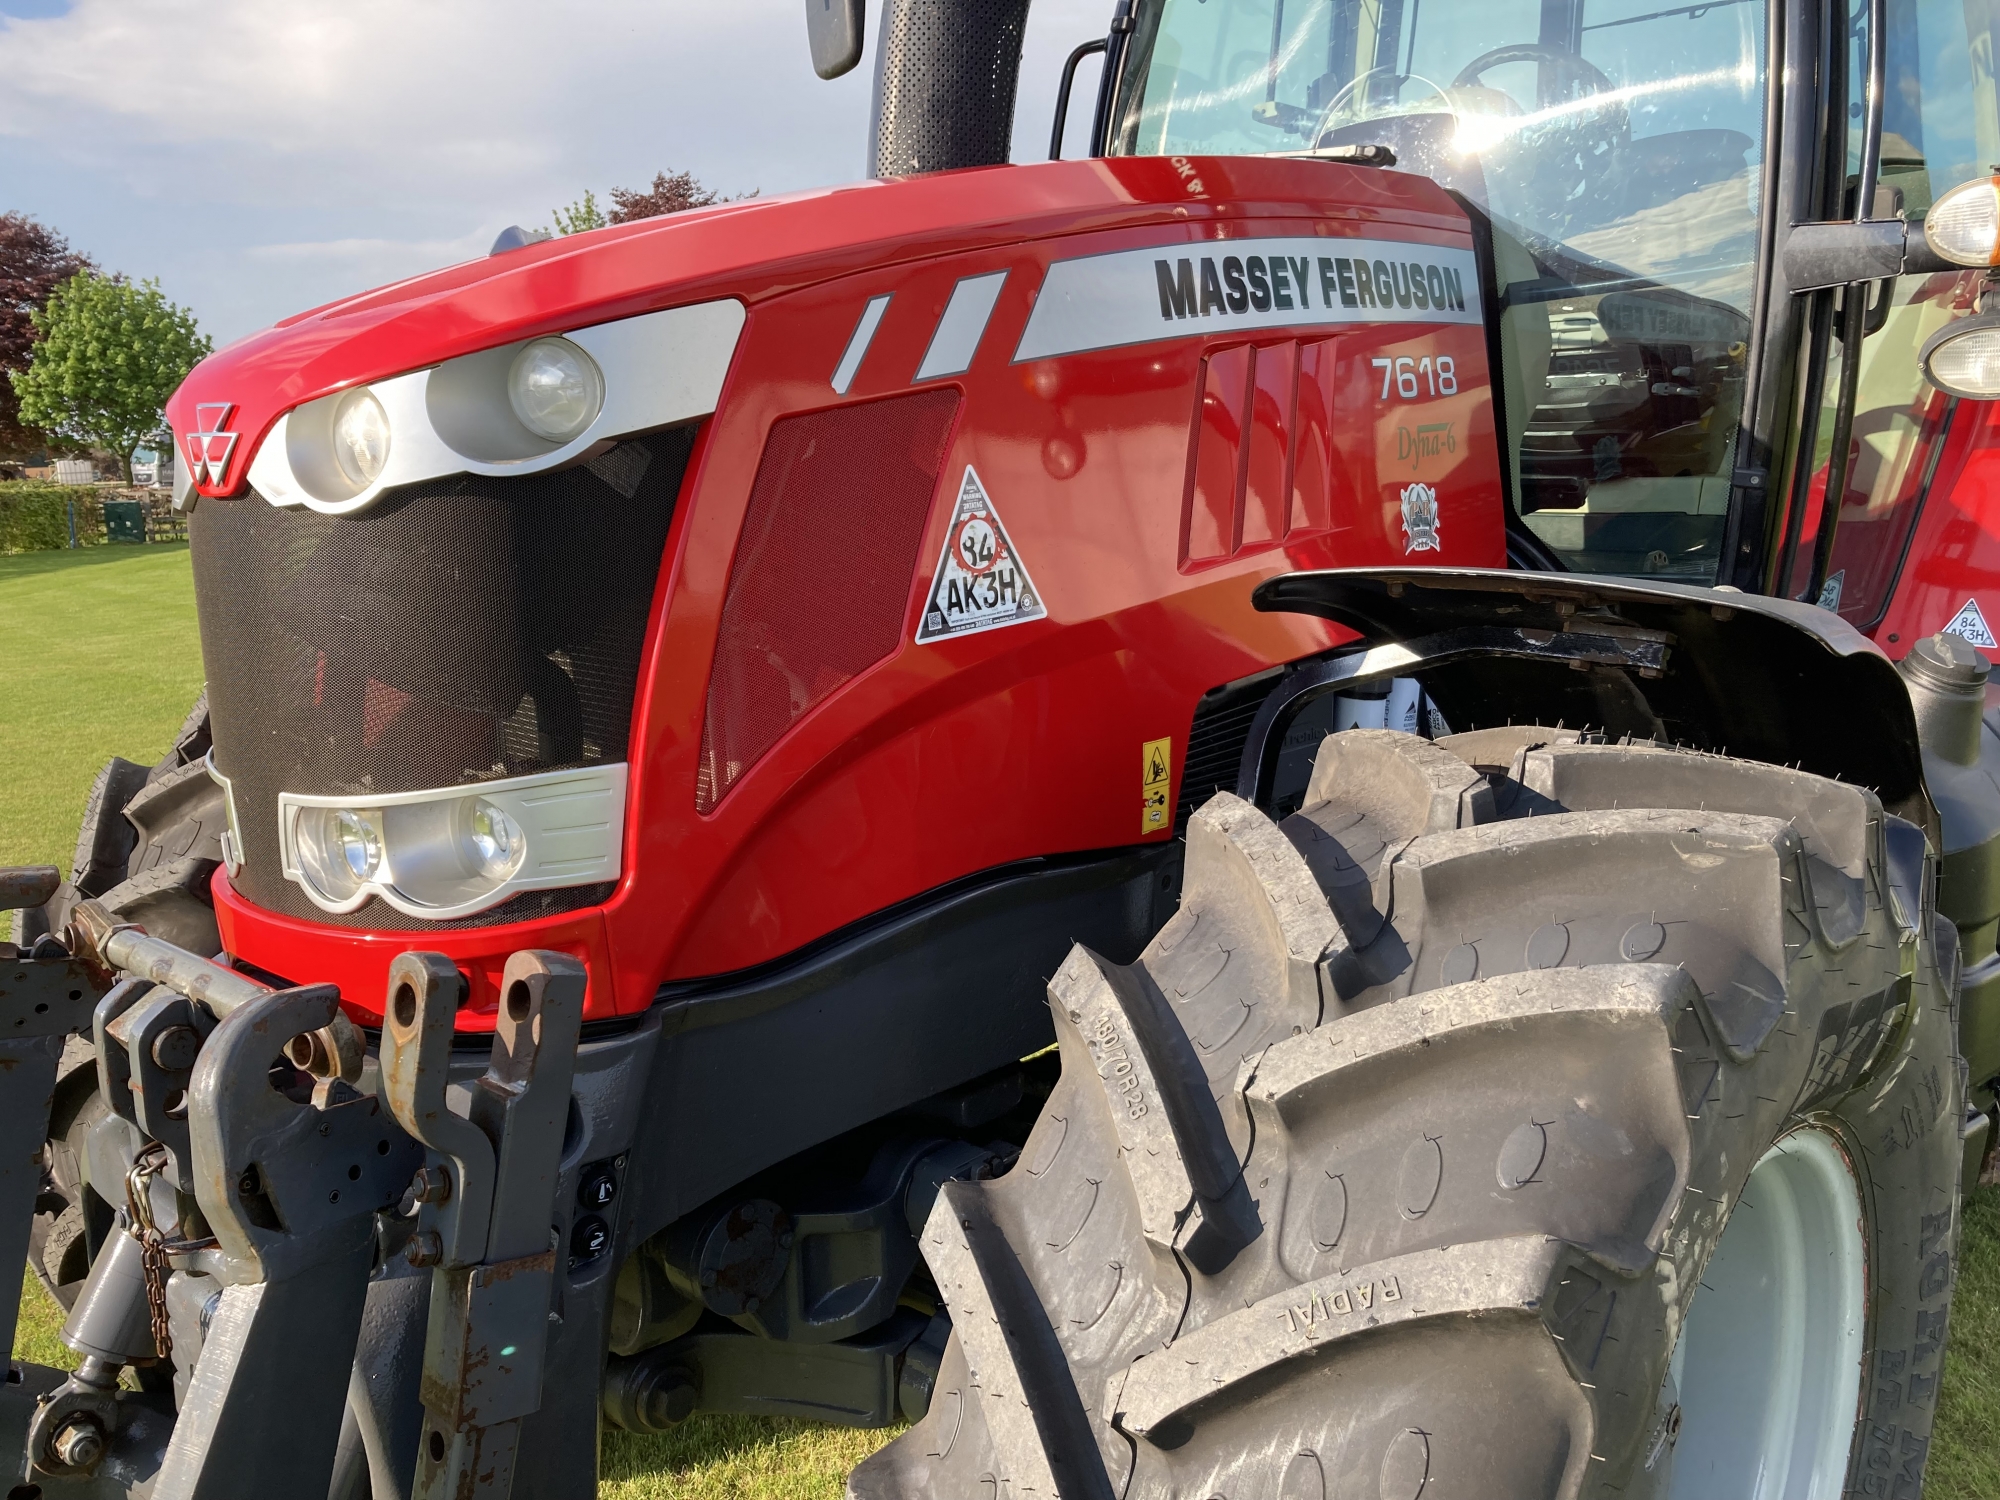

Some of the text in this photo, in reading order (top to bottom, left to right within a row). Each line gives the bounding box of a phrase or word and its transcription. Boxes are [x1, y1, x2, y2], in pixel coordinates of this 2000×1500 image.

[1154, 255, 1466, 321] MASSEY FERGUSON
[1371, 355, 1457, 400] 7618
[1397, 421, 1456, 471] Dyna-6
[962, 533, 993, 567] 84
[947, 568, 1016, 616] AK3H
[1961, 617, 1976, 628] 84
[1277, 1276, 1403, 1332] RADIAL
